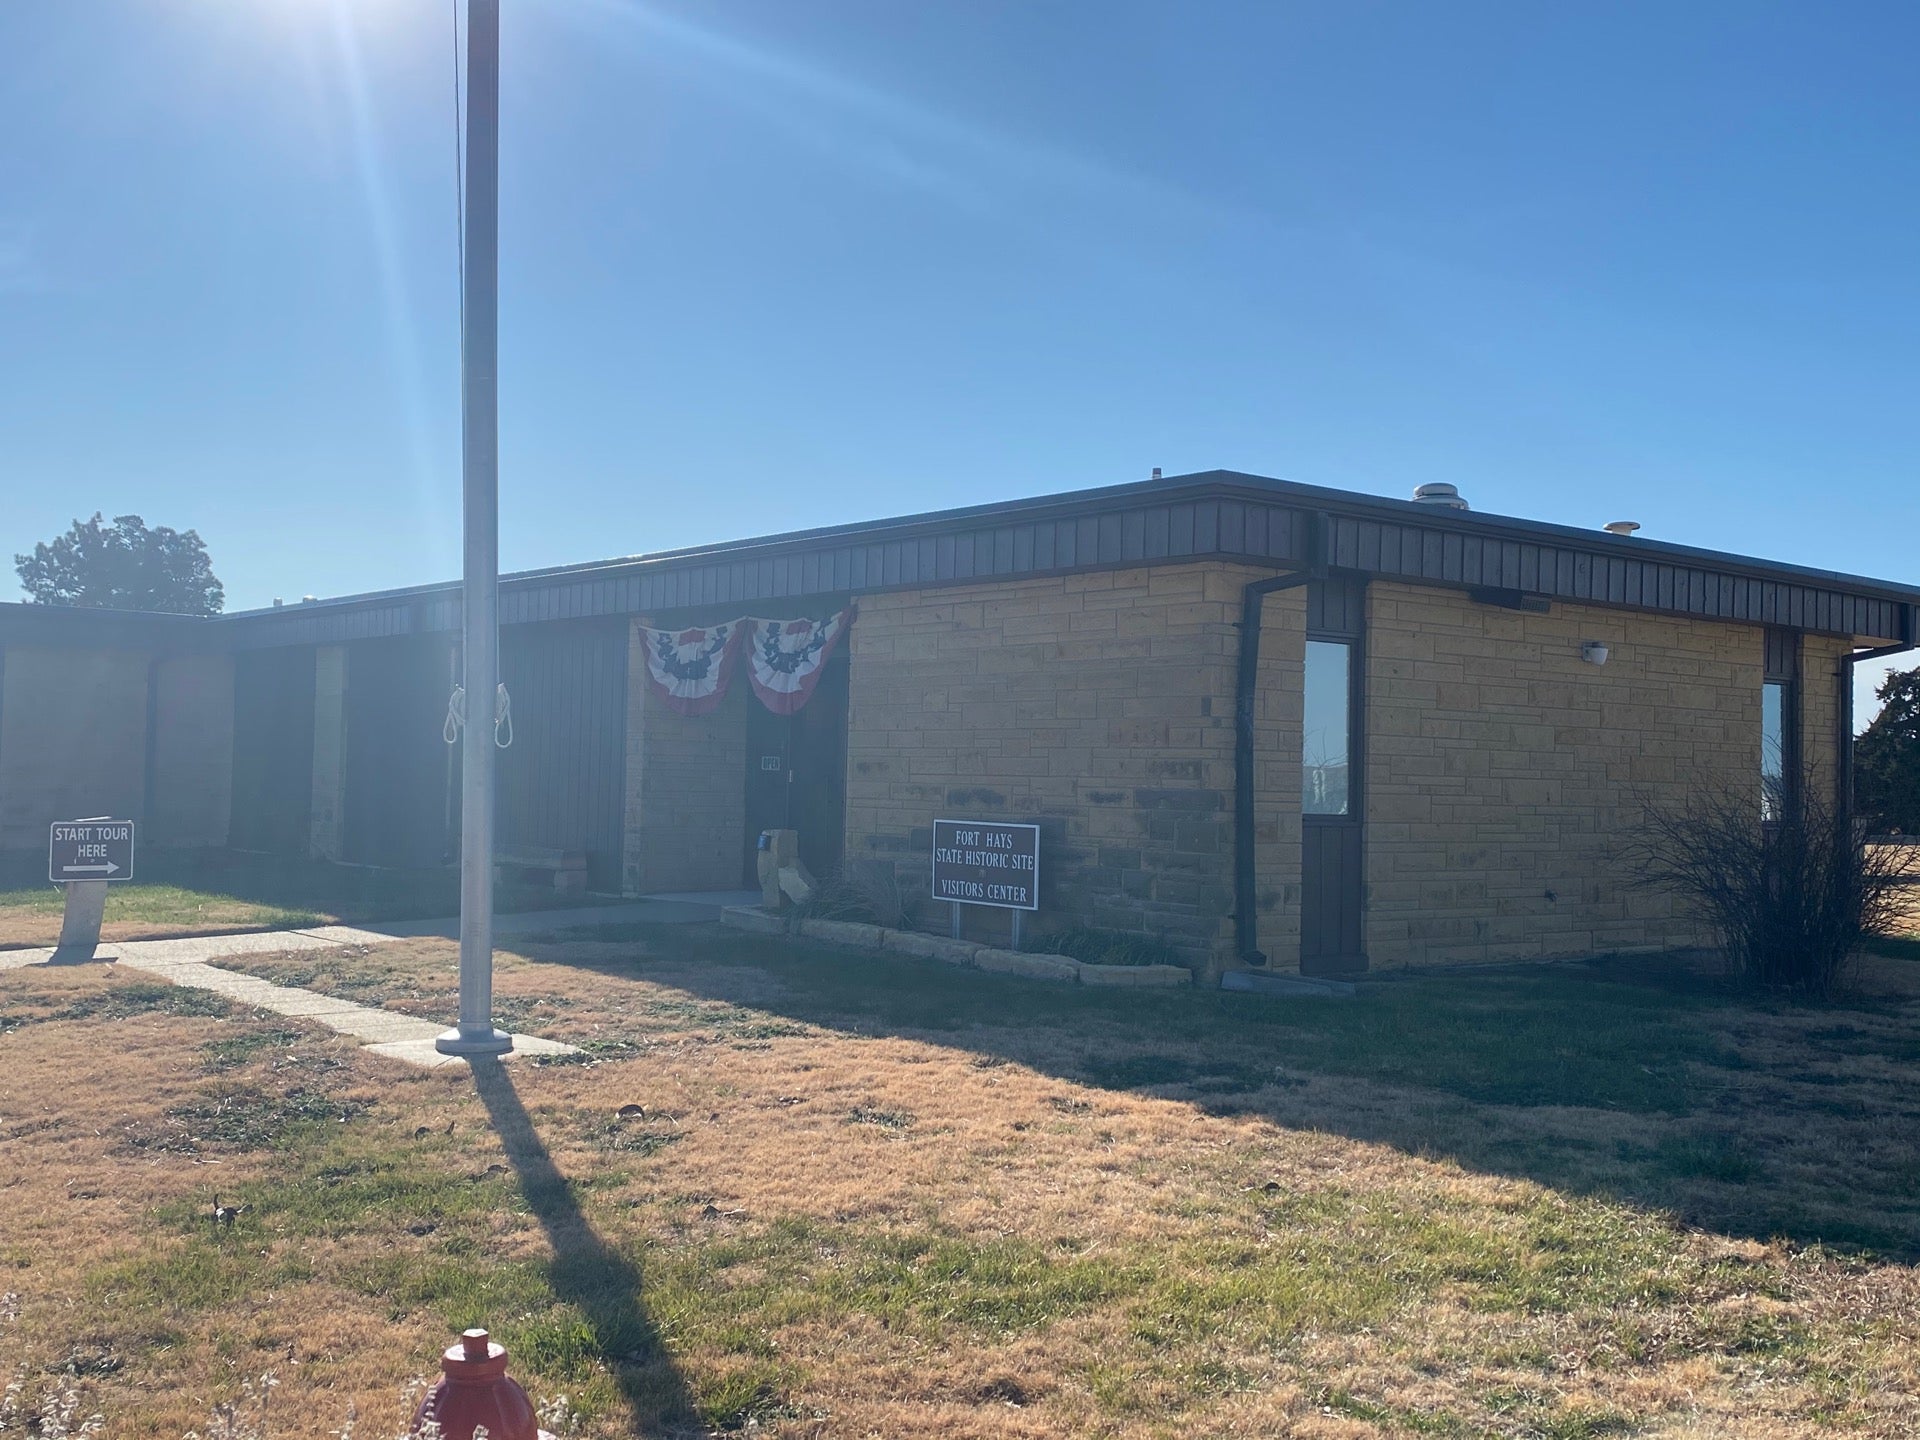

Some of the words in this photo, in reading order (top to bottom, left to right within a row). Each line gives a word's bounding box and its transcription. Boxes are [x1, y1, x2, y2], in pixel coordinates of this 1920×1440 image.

[55, 828, 92, 841] START
[96, 827, 128, 840] TOUR
[956, 831, 980, 846] FORT
[986, 833, 1012, 849] HAYS
[78, 844, 107, 857] HERE
[936, 848, 963, 864] STATE
[965, 851, 1009, 868] HISTORIC
[1012, 854, 1034, 870] SITE
[942, 880, 984, 897] VISITORS
[987, 884, 1027, 902] CENTER
